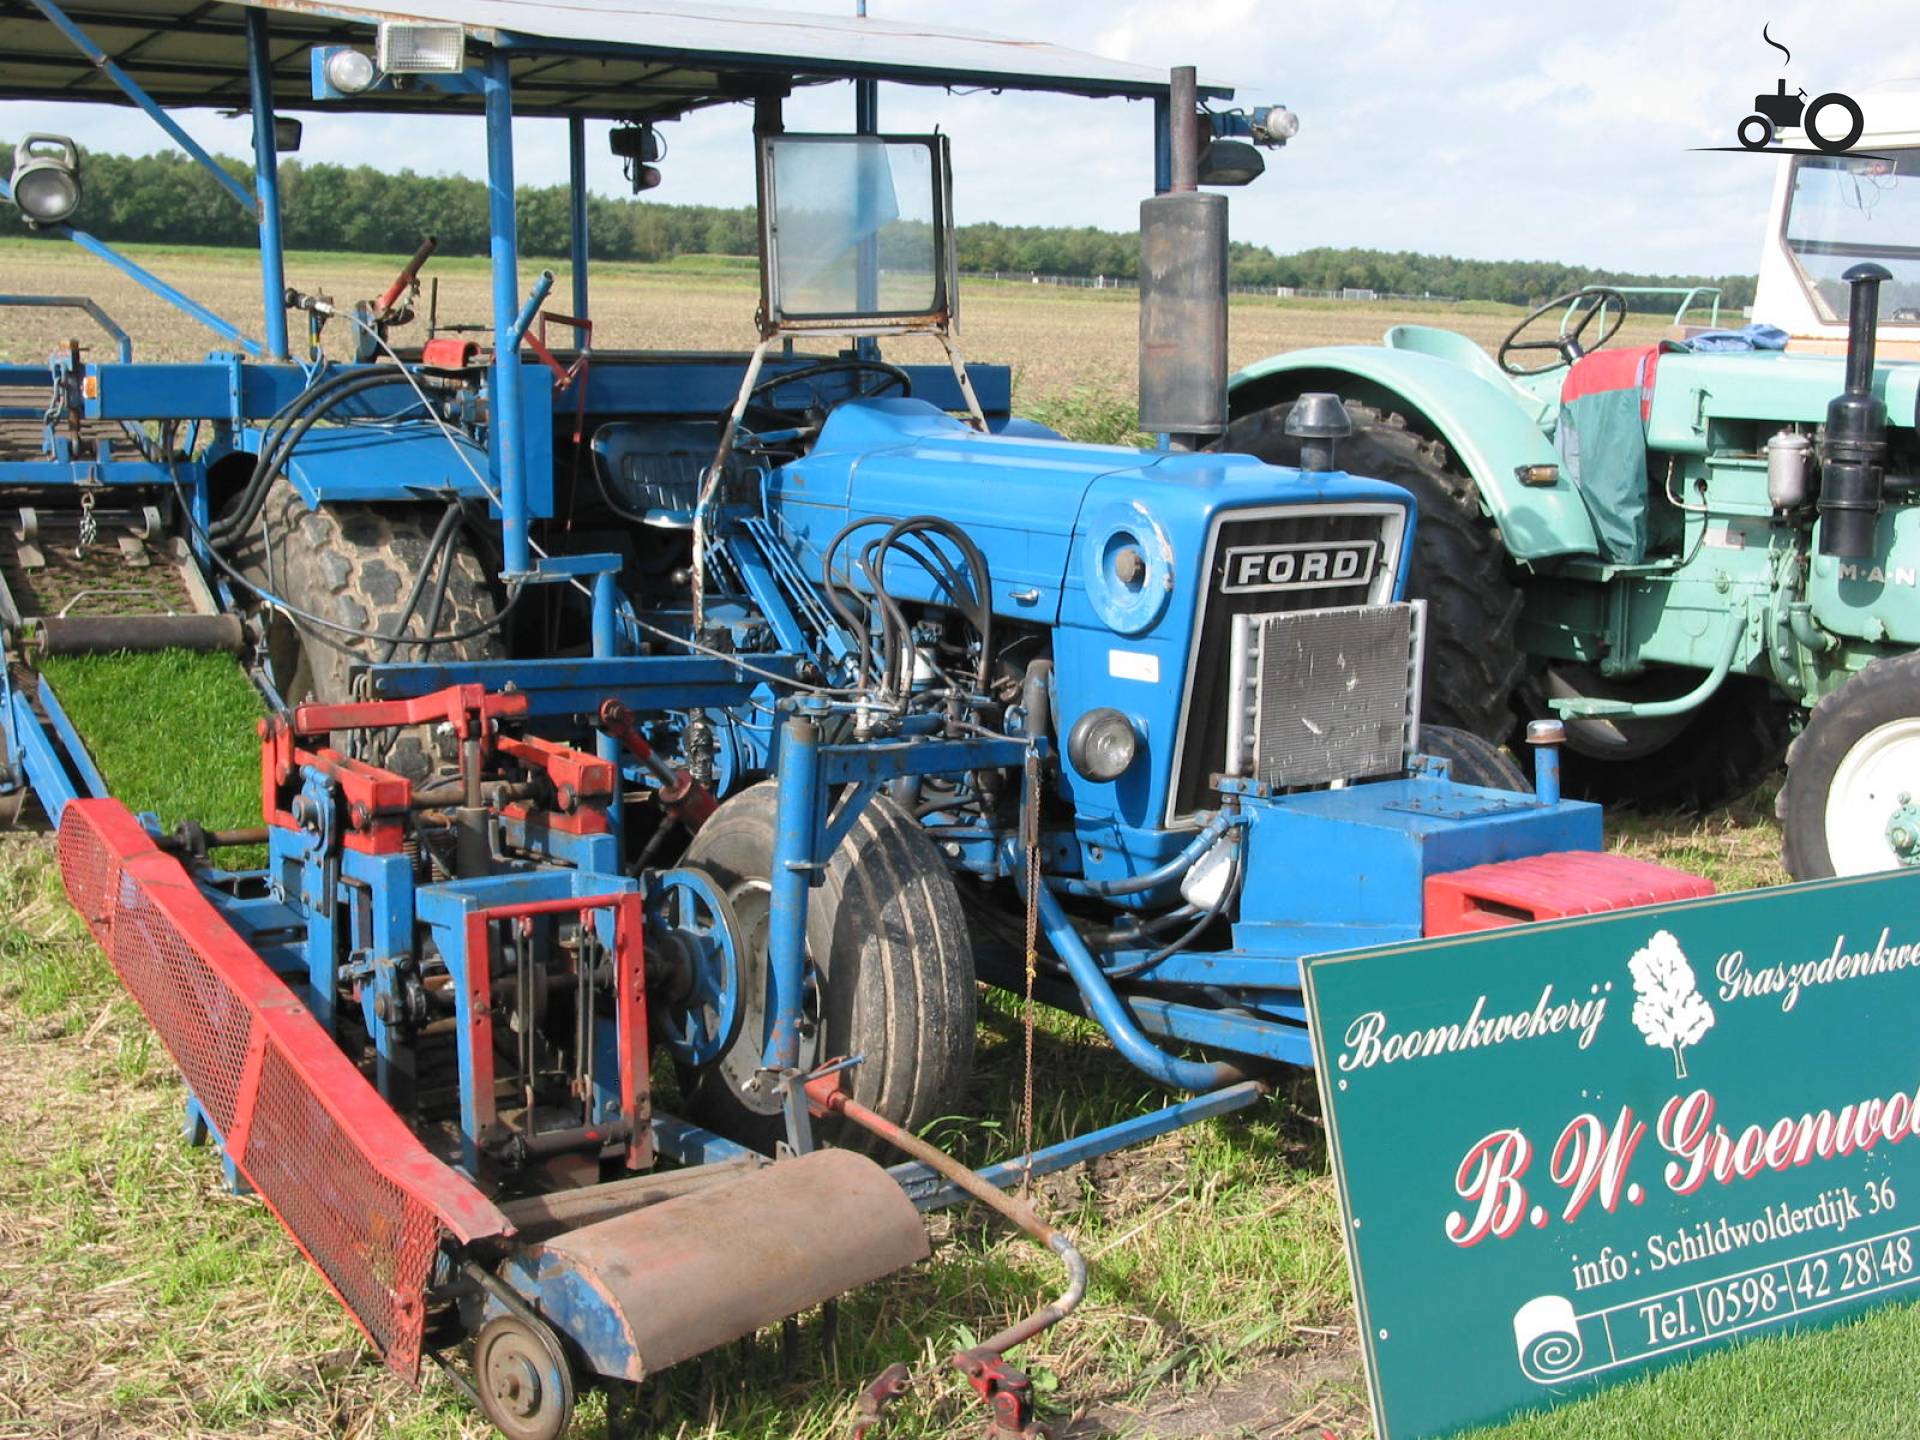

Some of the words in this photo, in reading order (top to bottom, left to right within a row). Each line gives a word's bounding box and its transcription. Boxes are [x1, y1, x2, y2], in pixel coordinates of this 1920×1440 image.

[1237, 550, 1359, 585] FORD
[1338, 981, 1612, 1072] Boomkwekerij
[1647, 1186, 1862, 1271] Schildwolderdijk
[1867, 1177, 1896, 1214] 36
[1639, 1295, 1696, 1345] Tel.
[1797, 1258, 1830, 1299] 42
[1838, 1246, 1872, 1291] 28
[1880, 1236, 1913, 1277] 48
